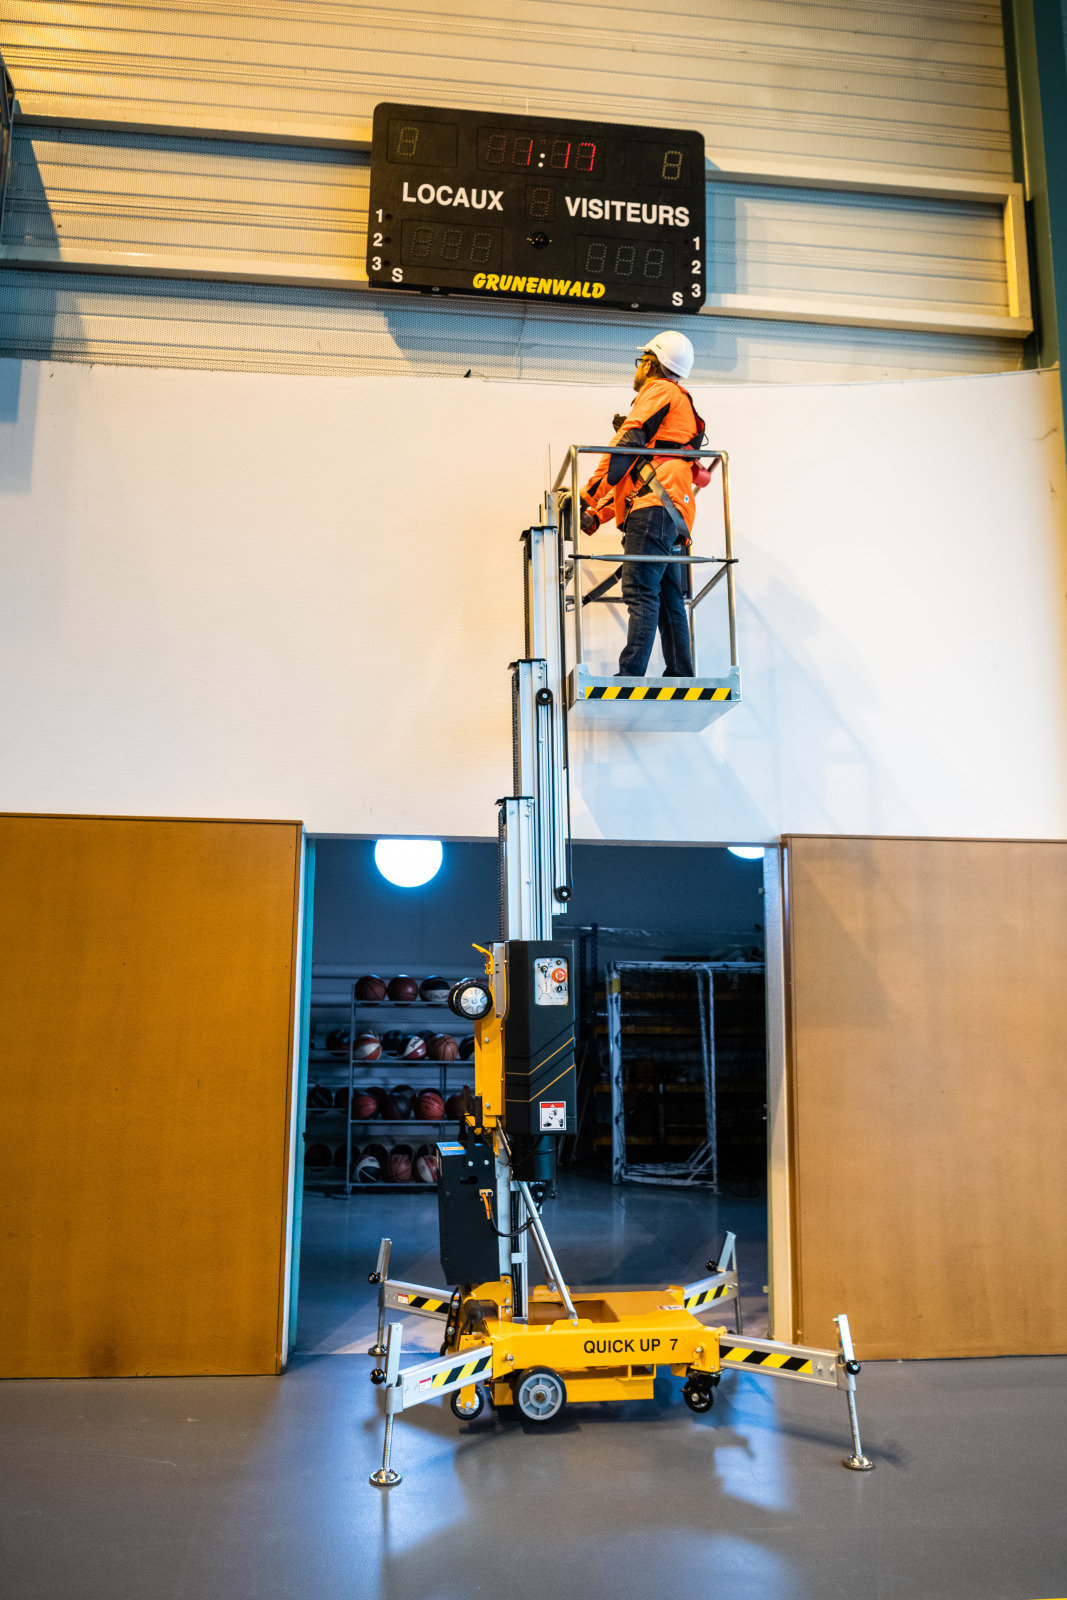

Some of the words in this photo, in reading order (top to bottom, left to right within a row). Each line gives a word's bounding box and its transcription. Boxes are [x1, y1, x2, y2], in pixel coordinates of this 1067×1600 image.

[402, 181, 504, 212] LOCAUX
[375, 208, 383, 223] 1
[564, 196, 690, 228] VISITEURS
[373, 232, 383, 248] 2
[692, 236, 700, 251] 1
[371, 255, 382, 271] 3
[691, 259, 702, 275] 2
[391, 267, 404, 283] S
[472, 272, 606, 299] GRUNENWALD
[691, 283, 702, 299] 3
[671, 291, 684, 307] S
[583, 1338, 635, 1354] QUICK
[640, 1338, 661, 1353] UP
[669, 1338, 679, 1351] 7
